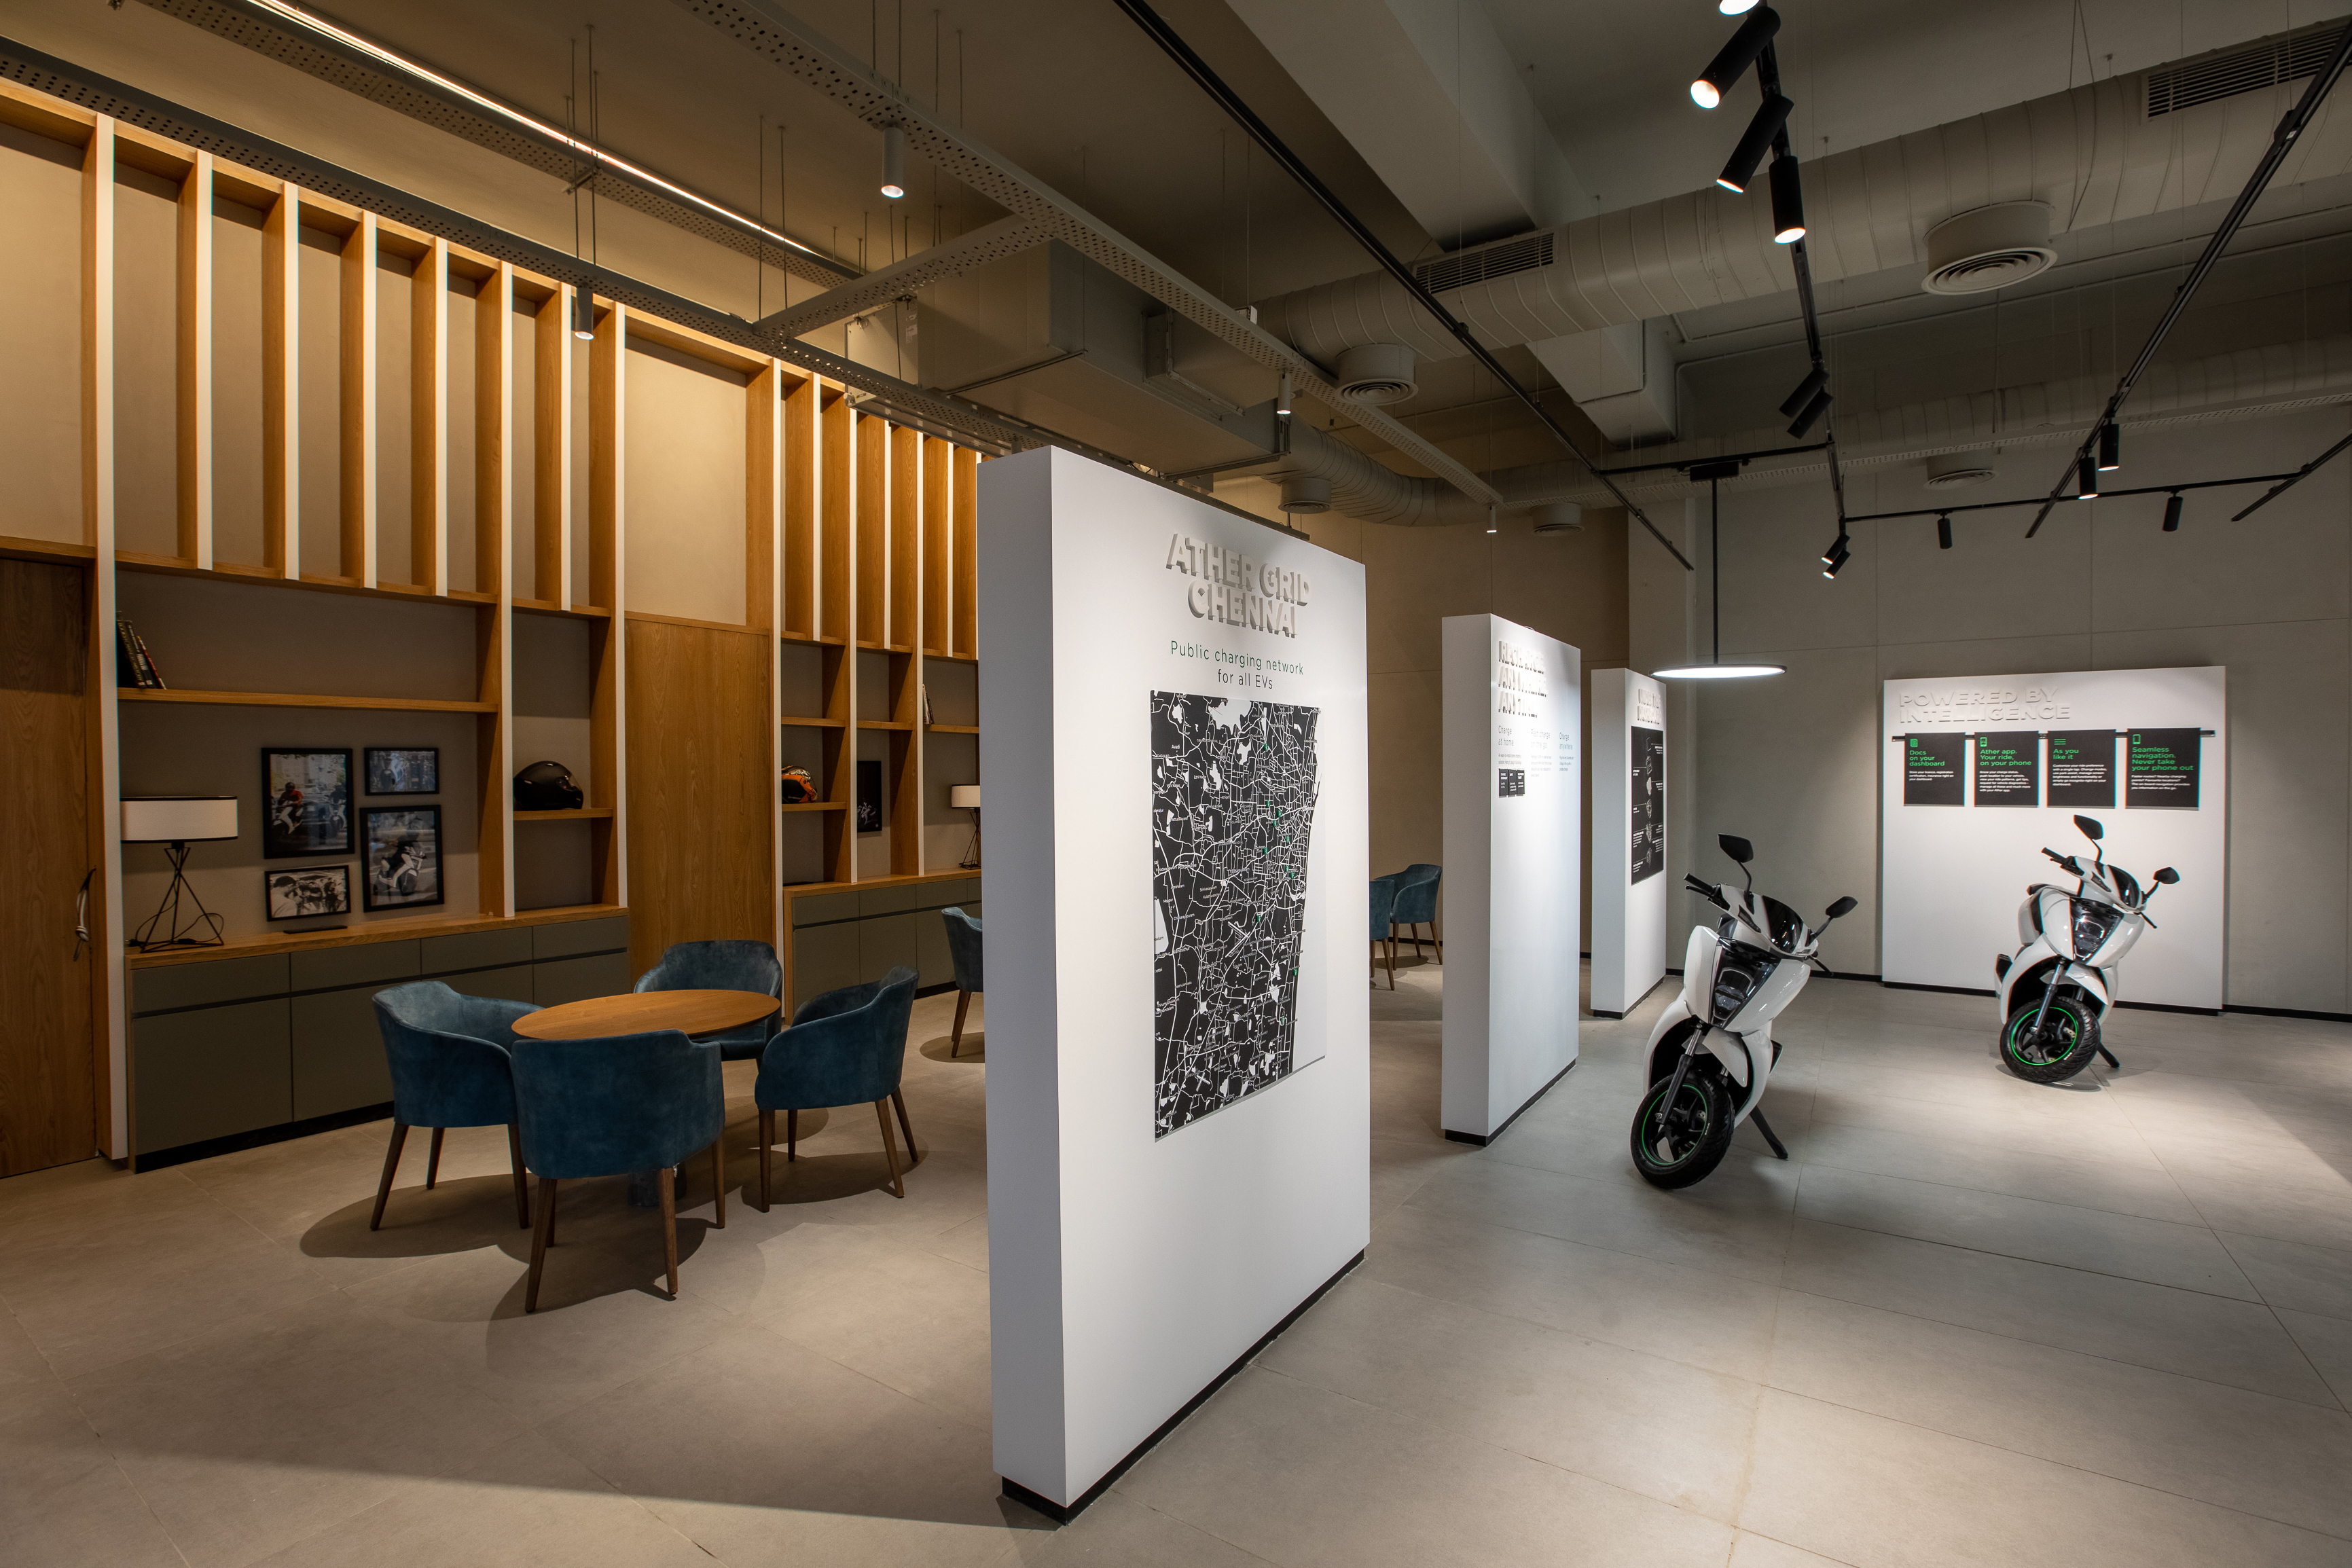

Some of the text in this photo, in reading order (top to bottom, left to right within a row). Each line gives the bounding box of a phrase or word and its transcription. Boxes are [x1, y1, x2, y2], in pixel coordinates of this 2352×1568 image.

[1165, 533, 1312, 607] ATHER GRID
[1188, 579, 1298, 638] CHENNAI
[1171, 640, 1304, 676] Public charging network
[1218, 669, 1273, 690] for all EVs
[1900, 686, 2059, 708] POWERED BY
[1900, 703, 2071, 723] INTELLIGENCE
[1498, 725, 1512, 735] Charge
[1559, 733, 1570, 741] Charge
